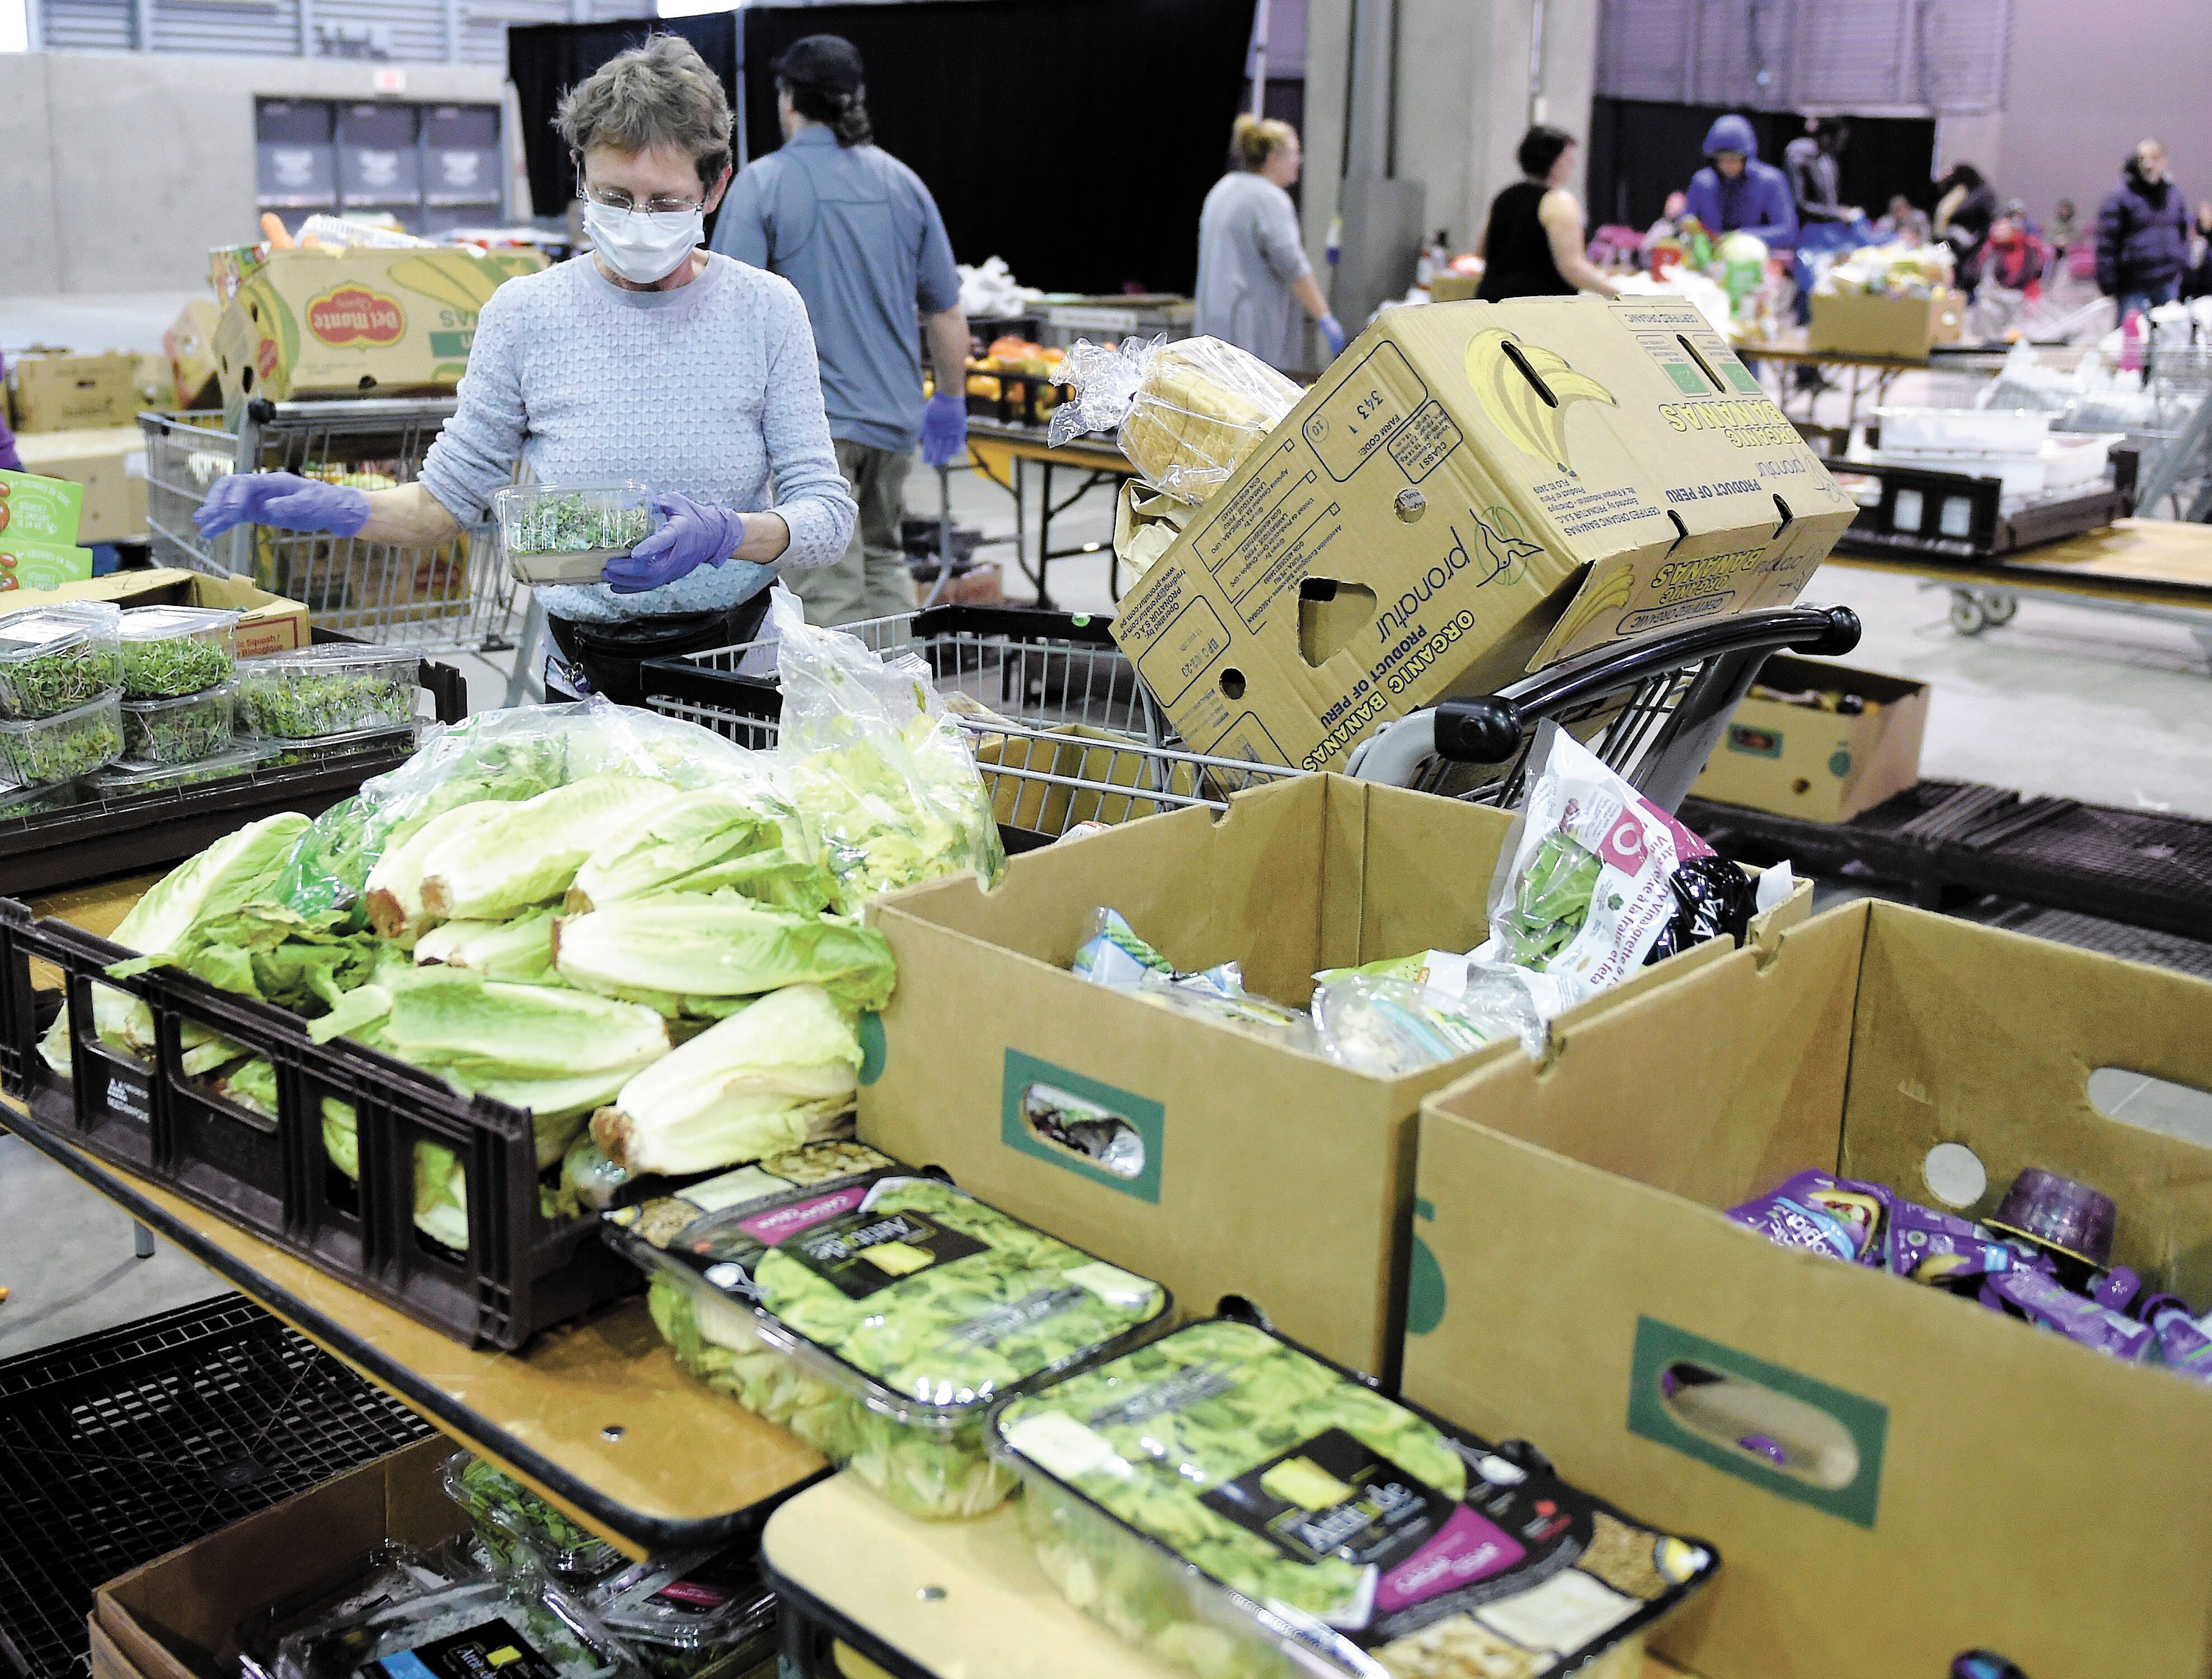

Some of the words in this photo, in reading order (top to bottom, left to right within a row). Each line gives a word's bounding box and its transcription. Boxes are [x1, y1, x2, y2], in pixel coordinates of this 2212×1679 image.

[313, 312, 368, 331] Monte
[1354, 389, 1385, 420] 343
[1658, 399, 1787, 432] BANANAS
[1378, 413, 1401, 435] FARM
[1357, 433, 1381, 457] CODE:
[1724, 426, 1801, 448] ORGANIC
[1422, 440, 1447, 466] CLASS
[1665, 487, 1695, 502] PERU
[1697, 485, 1712, 498] OF
[1713, 478, 1761, 496] PRODUCT
[1222, 514, 1237, 529] PERU
[1598, 512, 1629, 526] ORGANIC
[1628, 506, 1660, 520] CERTIFIED
[1563, 520, 1599, 536] BANANAS
[1243, 546, 1257, 561] PERU
[1272, 570, 1287, 584] PERU
[1651, 547, 1765, 587] BANANAS
[1374, 525, 1471, 643] pronatur
[1659, 575, 1729, 604] ORGANIC
[1118, 566, 1176, 629] www.pronatur.com.pe
[1118, 568, 1186, 641] trading@pronatur.com.pe
[1149, 586, 1182, 622] PRONATUR
[1152, 601, 1180, 631] Operated
[1143, 627, 1156, 640] by:
[1366, 623, 1428, 684] PRODUCT
[1384, 606, 1478, 696] ORGANIC
[1349, 678, 1371, 699] OF
[1318, 694, 1354, 730] PERU
[1299, 690, 1389, 777] BANANAS
[1628, 902, 1643, 916] la
[1636, 893, 1650, 904] à
[1607, 949, 1619, 962] et
[1589, 963, 1613, 985] feta
